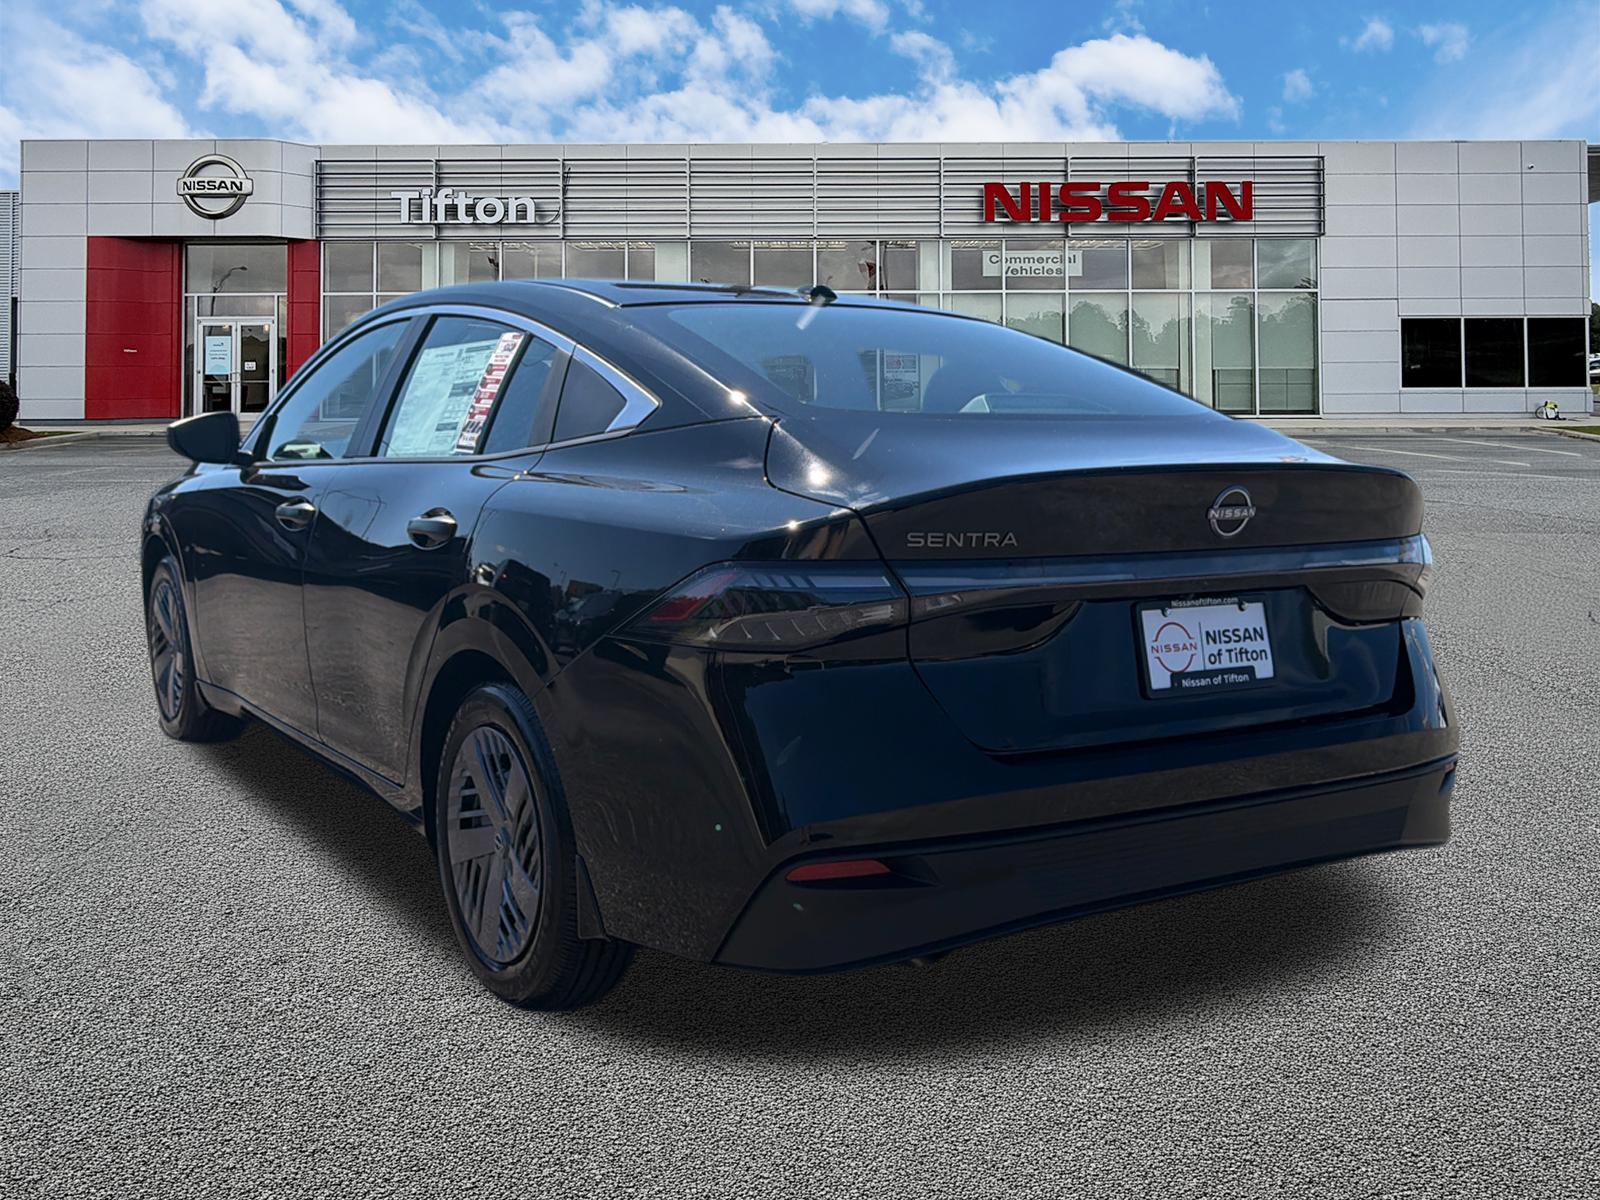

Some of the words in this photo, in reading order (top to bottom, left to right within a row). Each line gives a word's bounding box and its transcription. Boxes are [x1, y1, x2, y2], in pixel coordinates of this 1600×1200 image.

[182, 180, 243, 191] NISSAN
[391, 188, 536, 224] Tifton
[983, 181, 1253, 222] NISSAN
[1209, 507, 1256, 519] NISSAN
[906, 532, 1018, 548] SENTRA
[1205, 627, 1265, 645] NISSAN
[1151, 642, 1198, 654] NISSAN
[1208, 650, 1222, 665] of
[1225, 647, 1268, 664] Tifton
[1182, 677, 1211, 688] Nissan
[1213, 675, 1222, 685] of
[1223, 673, 1249, 684] Tifton
